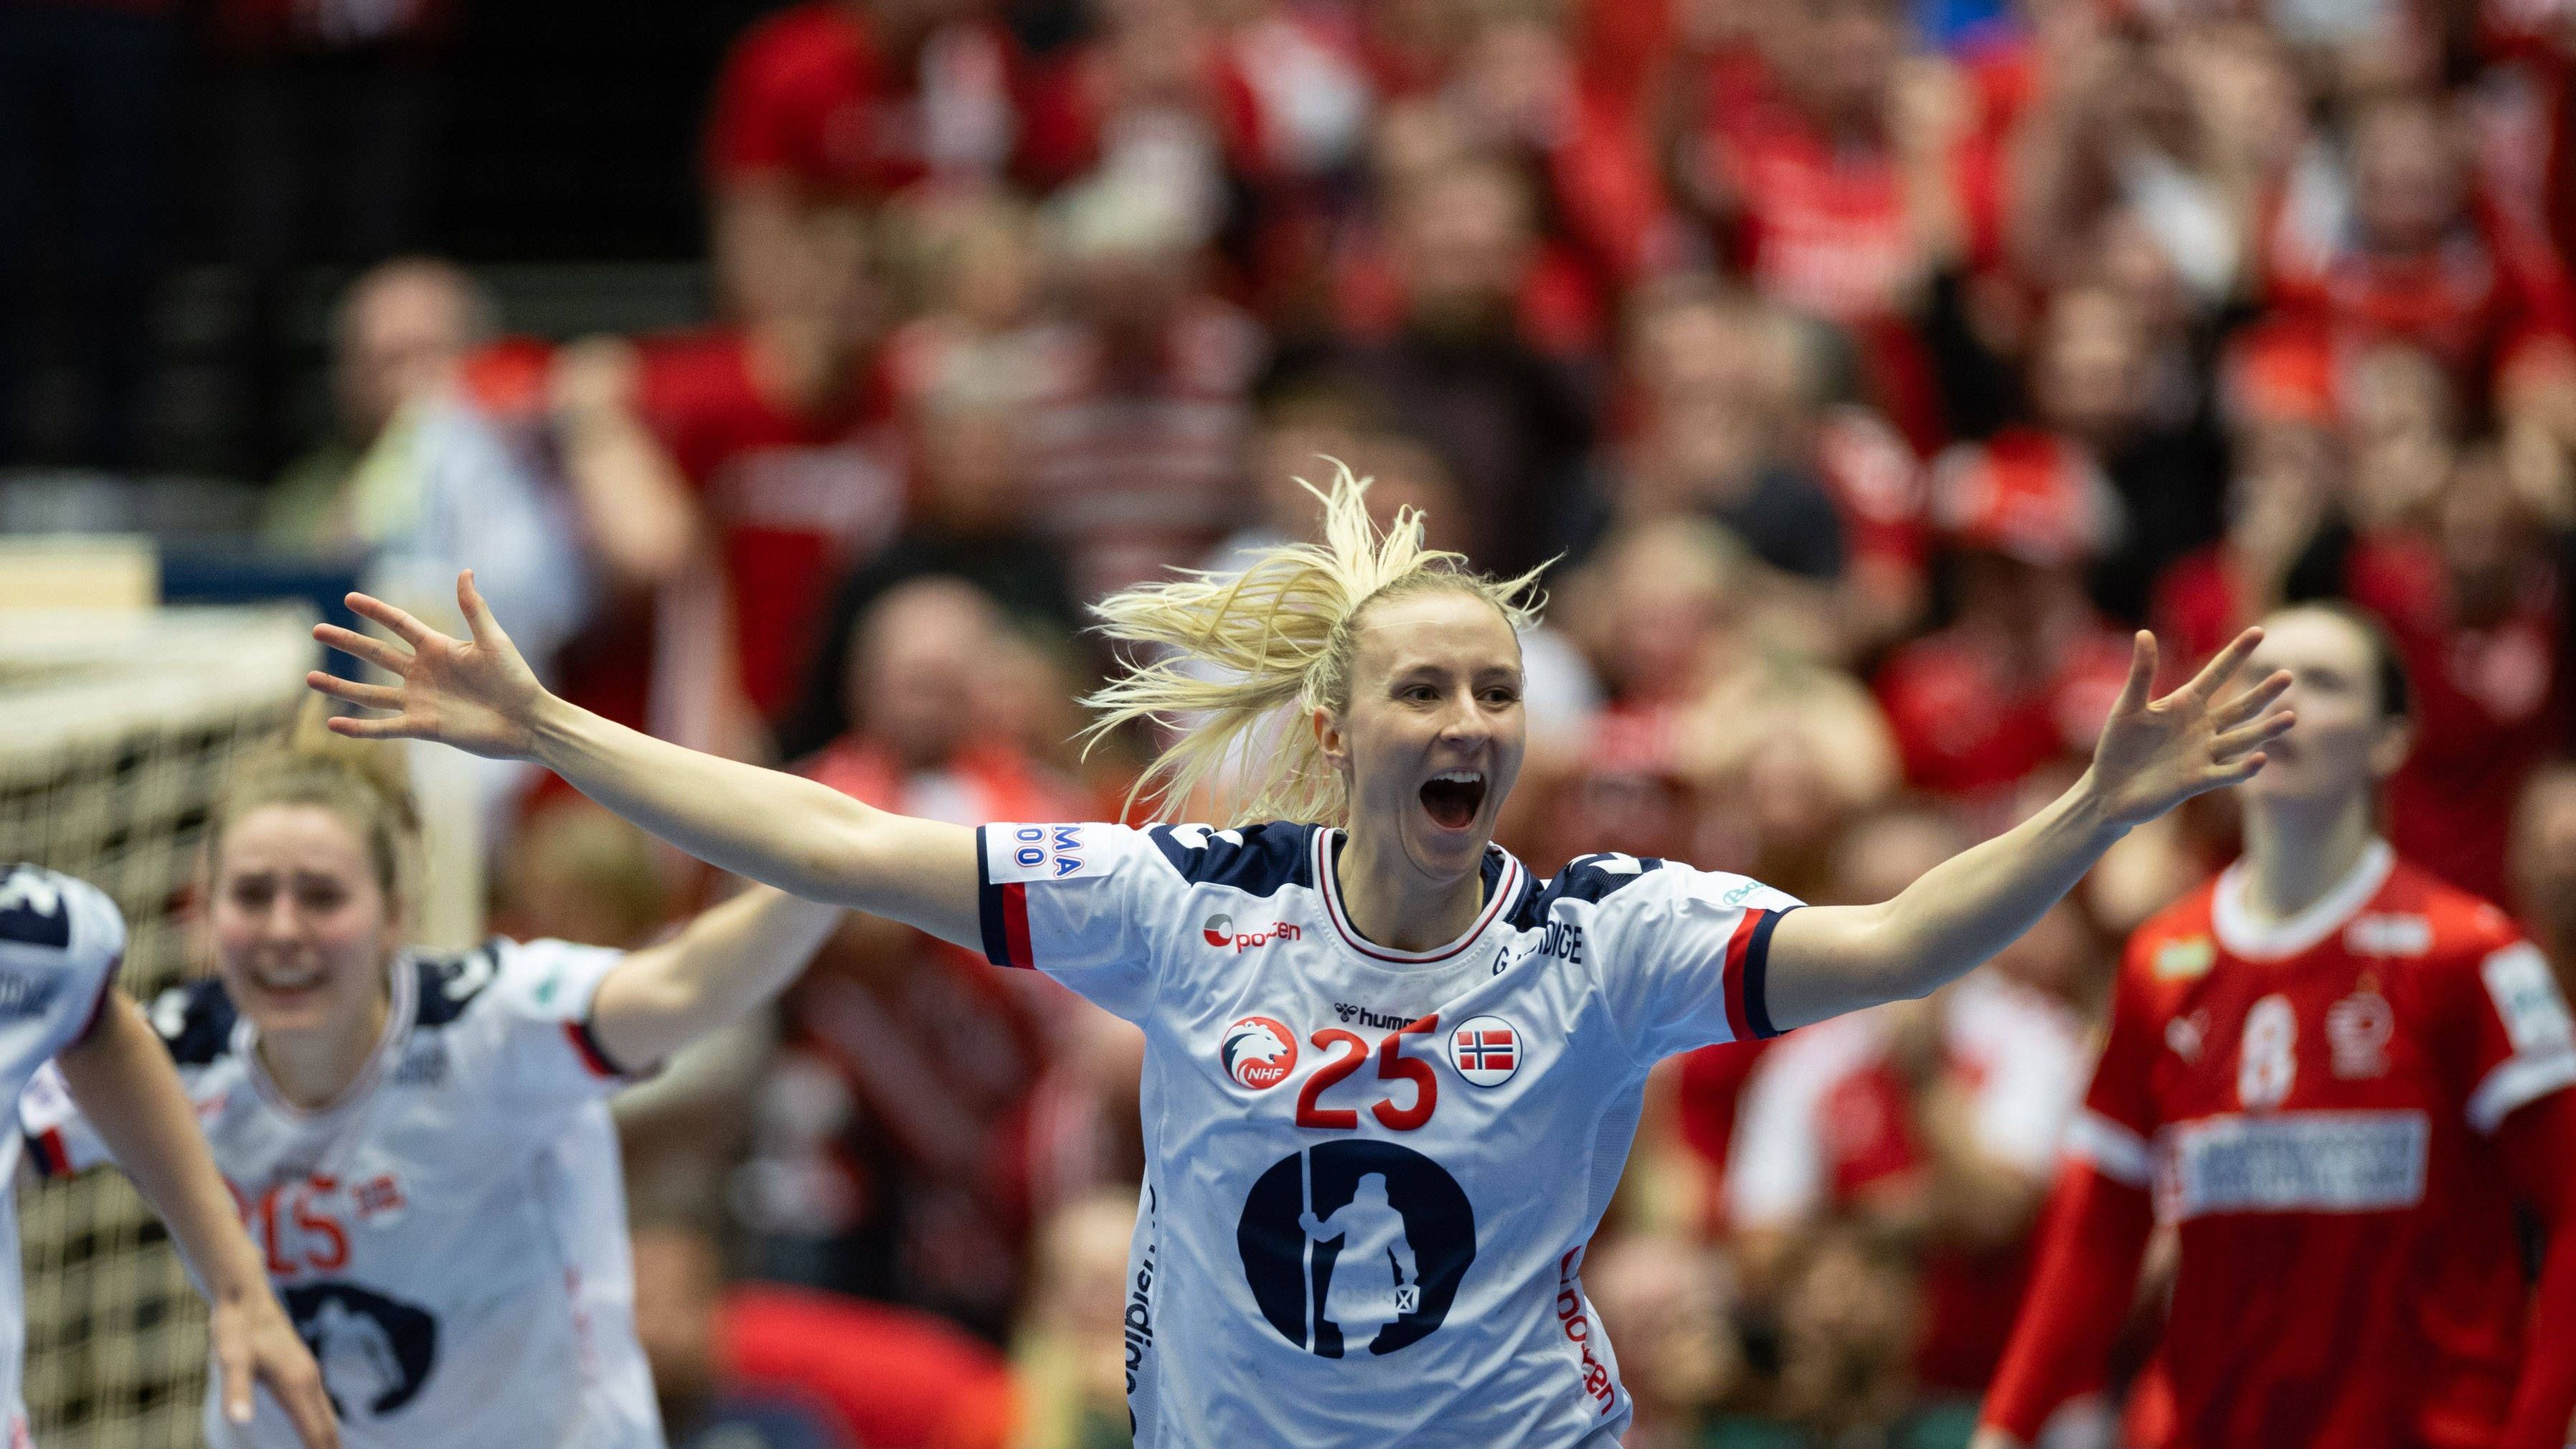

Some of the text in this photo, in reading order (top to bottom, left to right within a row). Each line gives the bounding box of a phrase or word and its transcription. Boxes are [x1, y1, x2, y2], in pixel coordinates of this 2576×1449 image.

[1016, 826, 1046, 868] 00
[1053, 825, 1084, 877] MA
[1236, 922, 1301, 953] poen
[1248, 1067, 1284, 1080] NHF
[1296, 1014, 1439, 1131] 25
[1557, 1288, 1615, 1417] poen
